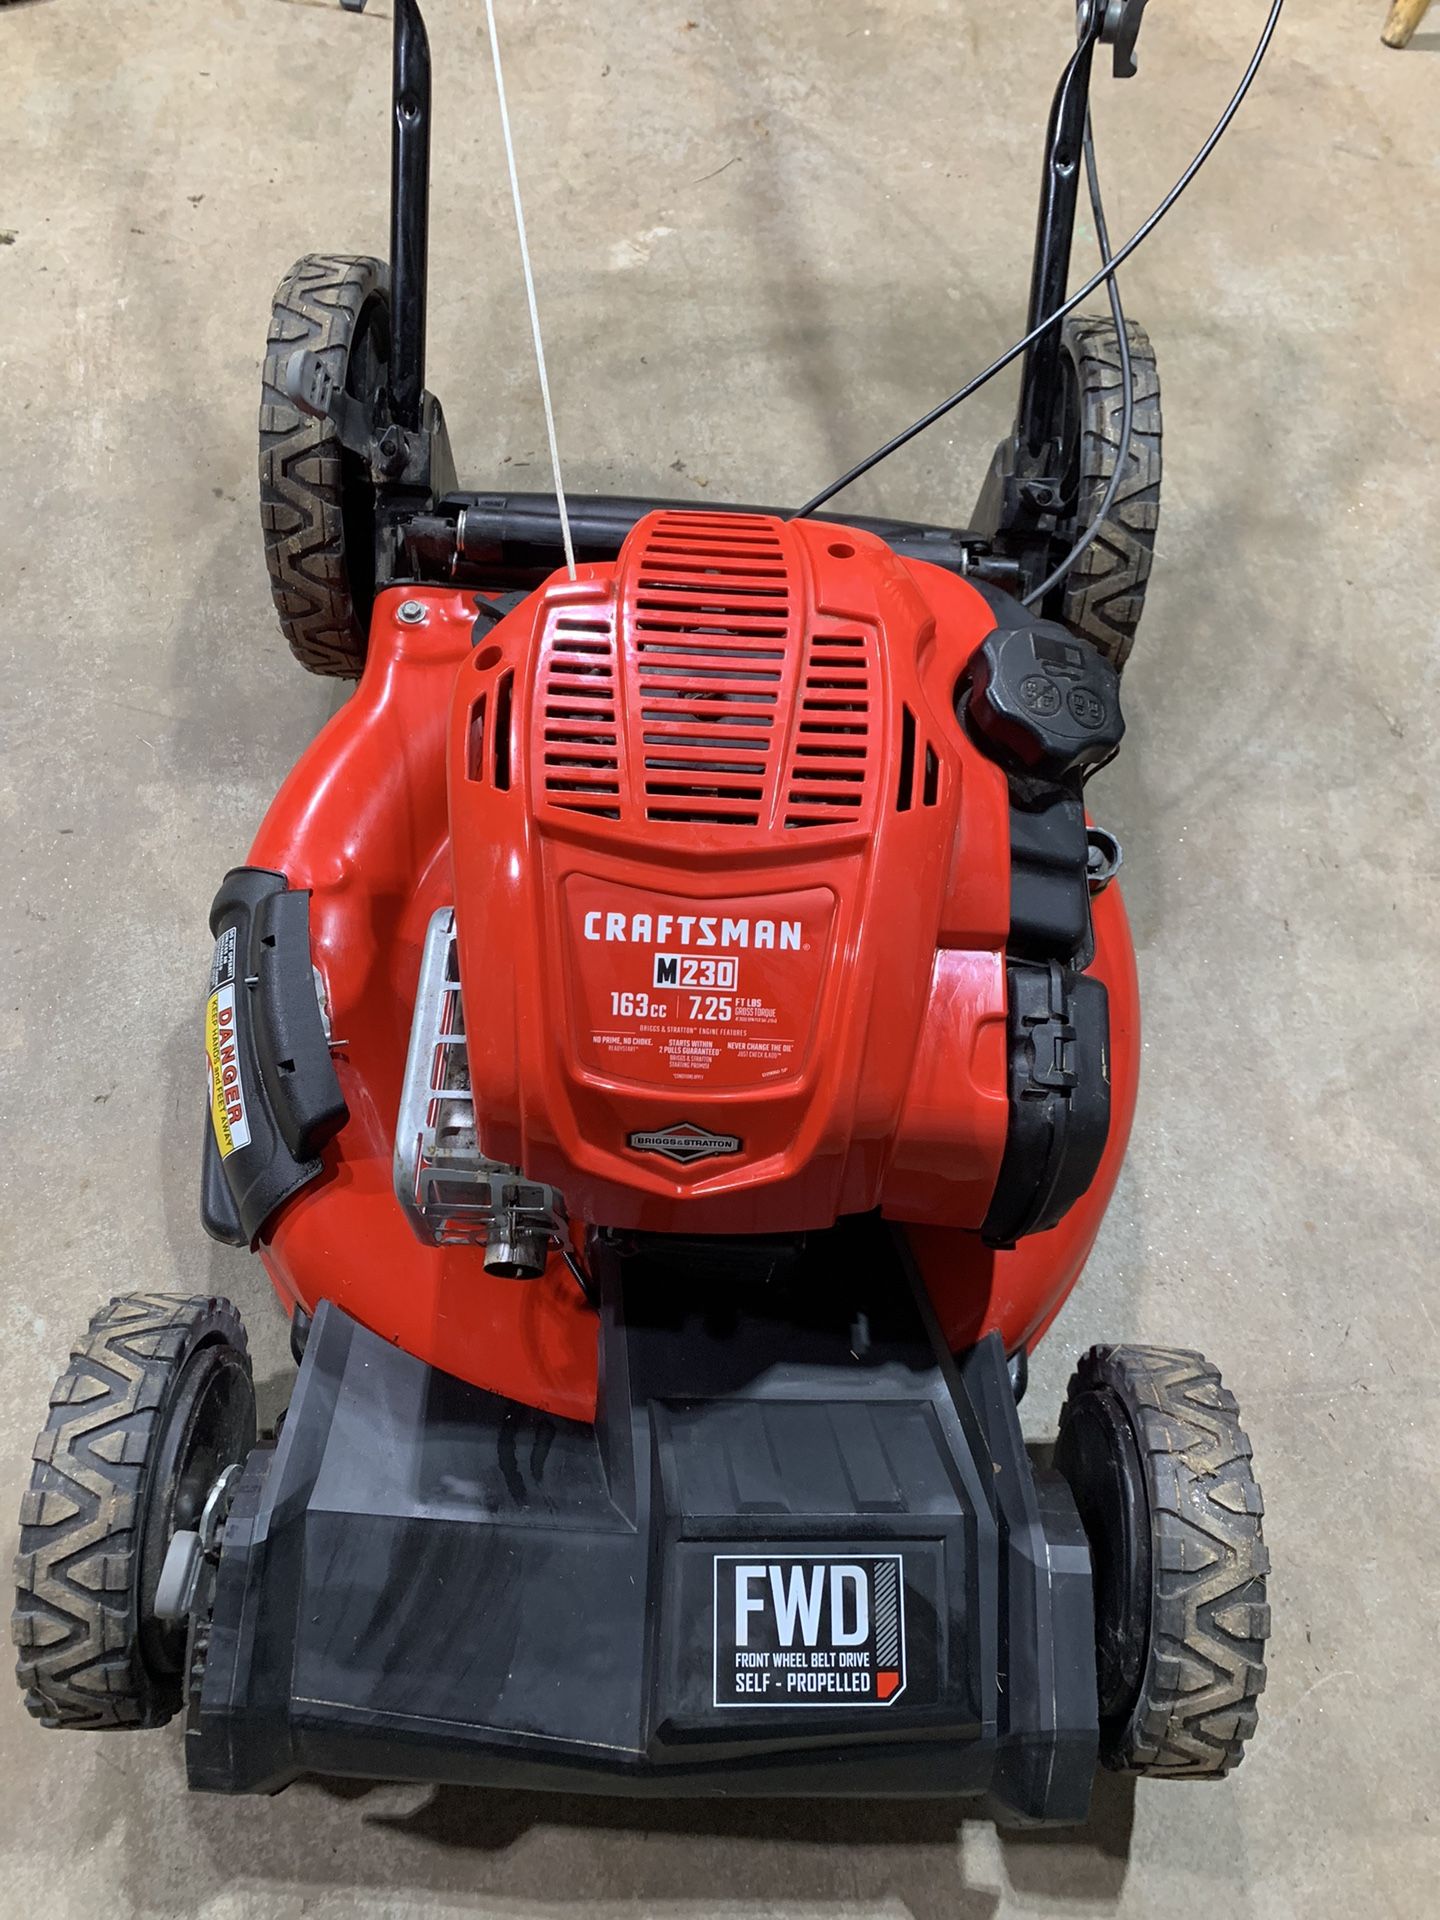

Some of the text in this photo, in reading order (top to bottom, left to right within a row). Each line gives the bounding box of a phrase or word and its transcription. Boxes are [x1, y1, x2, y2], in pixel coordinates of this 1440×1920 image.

[584, 911, 802, 950] CRAFTSMAN
[689, 996, 732, 1021] 7.25
[747, 998, 762, 1008] LBS
[640, 1025, 658, 1033] BRIGGS
[720, 1028, 747, 1036] FEATURES
[664, 1046, 681, 1054] PULLS
[669, 1039, 690, 1047] STARTS
[727, 1042, 746, 1050] NEVER
[747, 1043, 769, 1051] CHANGE
[771, 1044, 782, 1052] THE
[214, 1066, 222, 1085] and
[219, 1007, 243, 1125] DANGER
[217, 1086, 226, 1113] FEET
[221, 1117, 232, 1146] AWAY
[735, 1565, 869, 1647] FWD
[735, 1652, 870, 1668] FRONT WHEEL BELT DRIVE
[735, 1673, 770, 1692] SELF
[787, 1672, 870, 1692] PROPELLED
